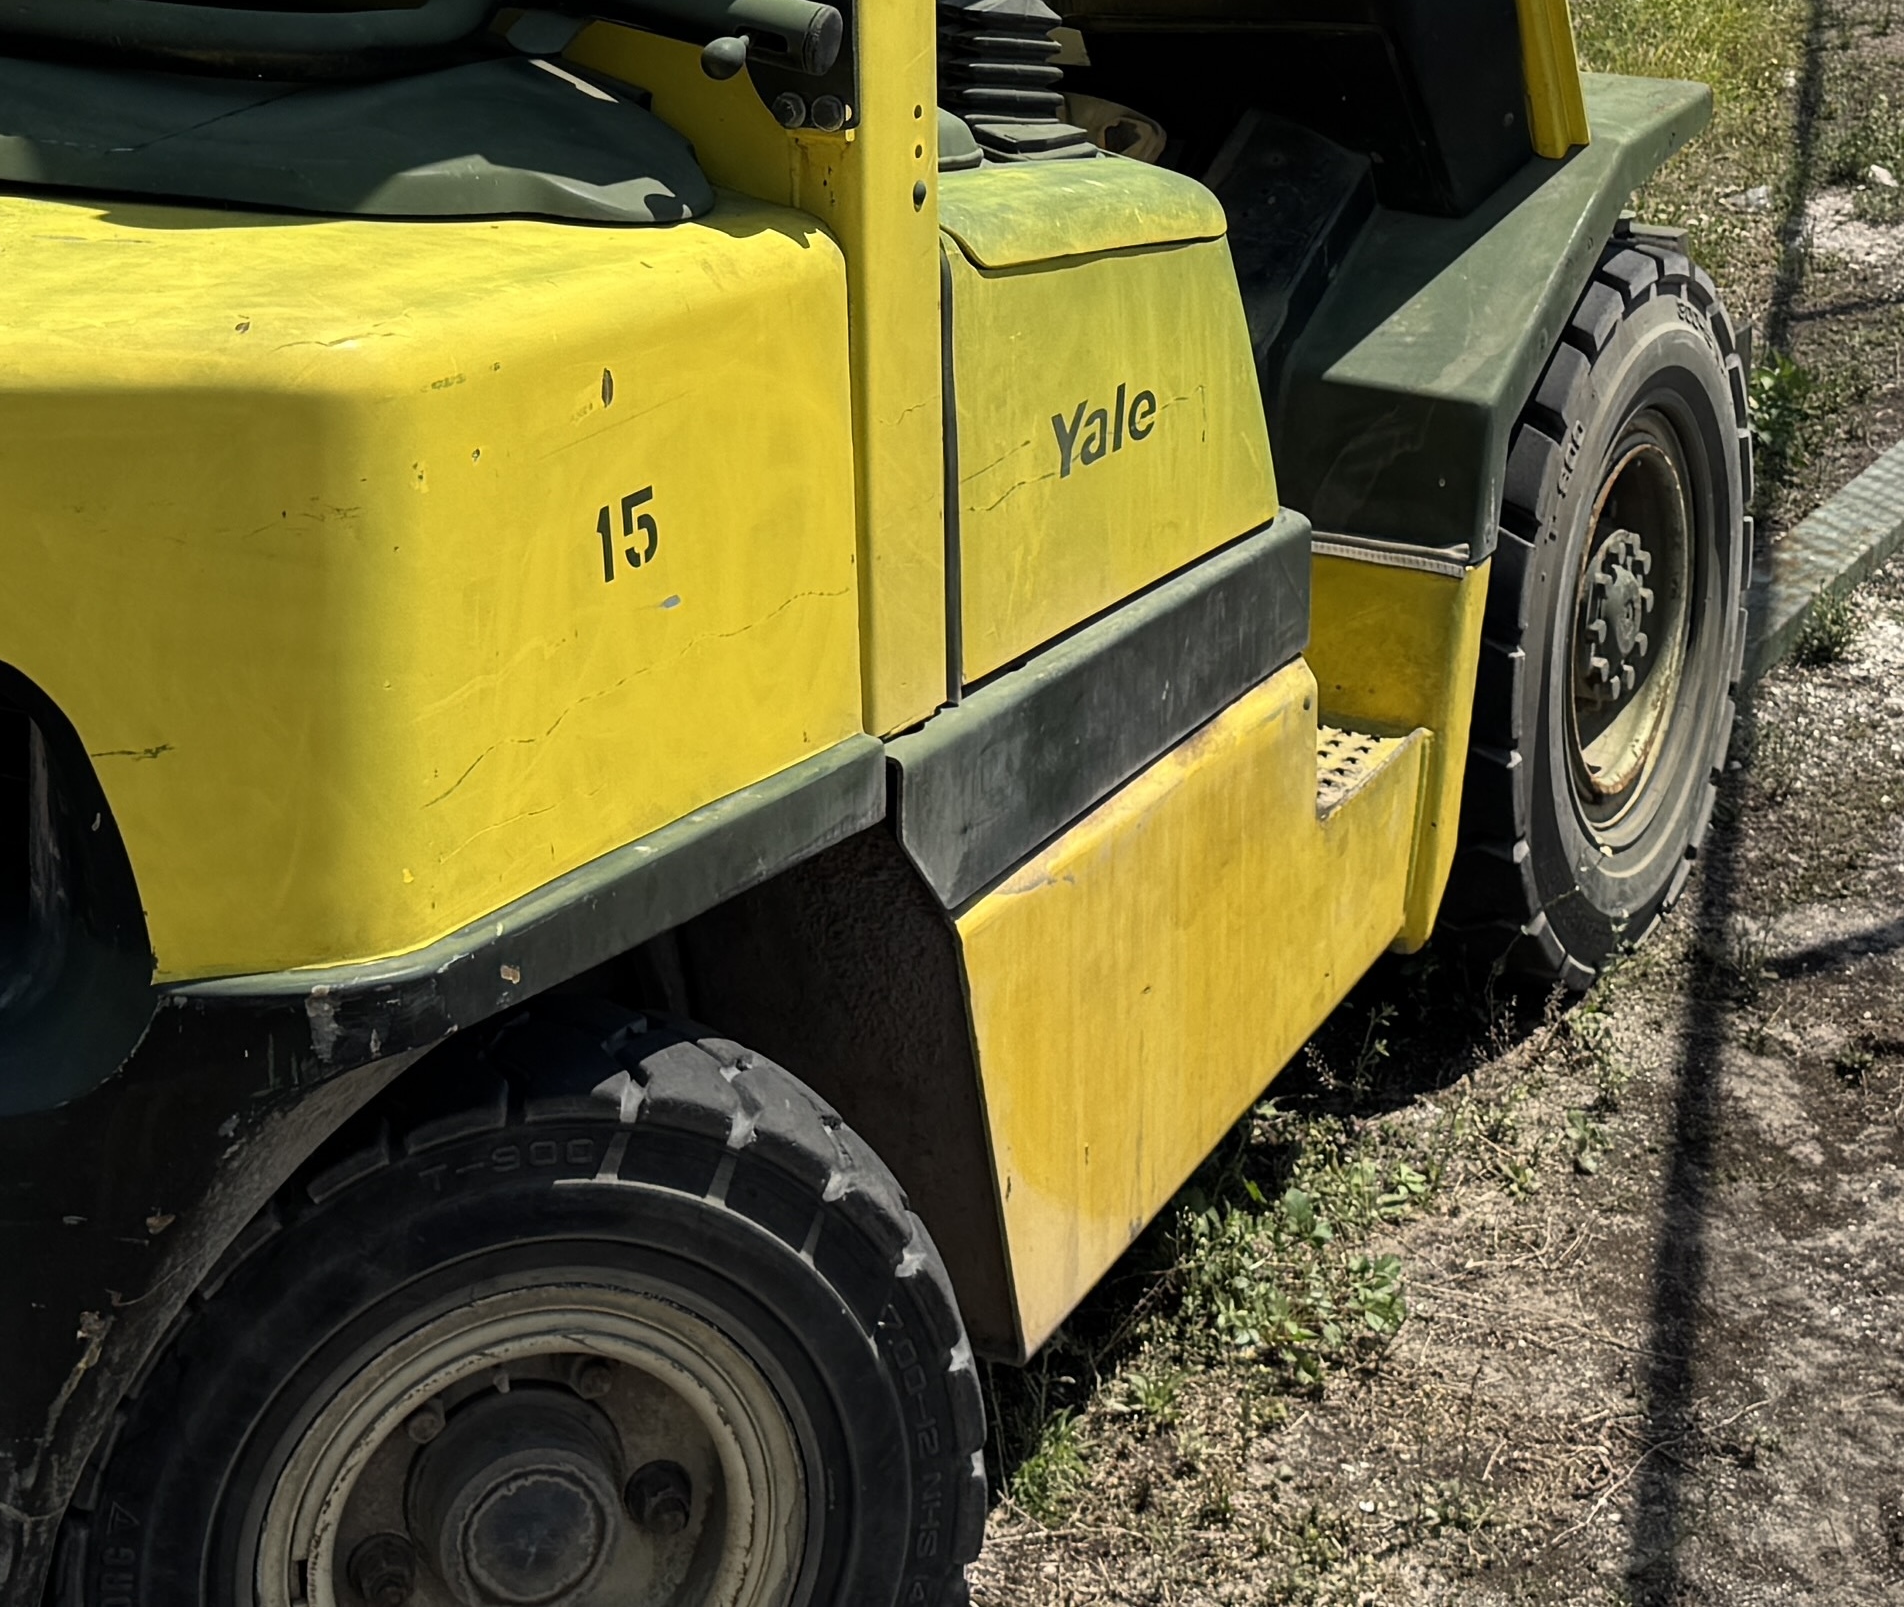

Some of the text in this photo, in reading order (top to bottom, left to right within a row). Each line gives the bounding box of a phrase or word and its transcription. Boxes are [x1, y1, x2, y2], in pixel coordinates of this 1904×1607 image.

[1050, 382, 1157, 479] Yale
[594, 485, 658, 584] 15
[417, 1138, 596, 1192] T-900
[917, 1471, 943, 1558] NHS
